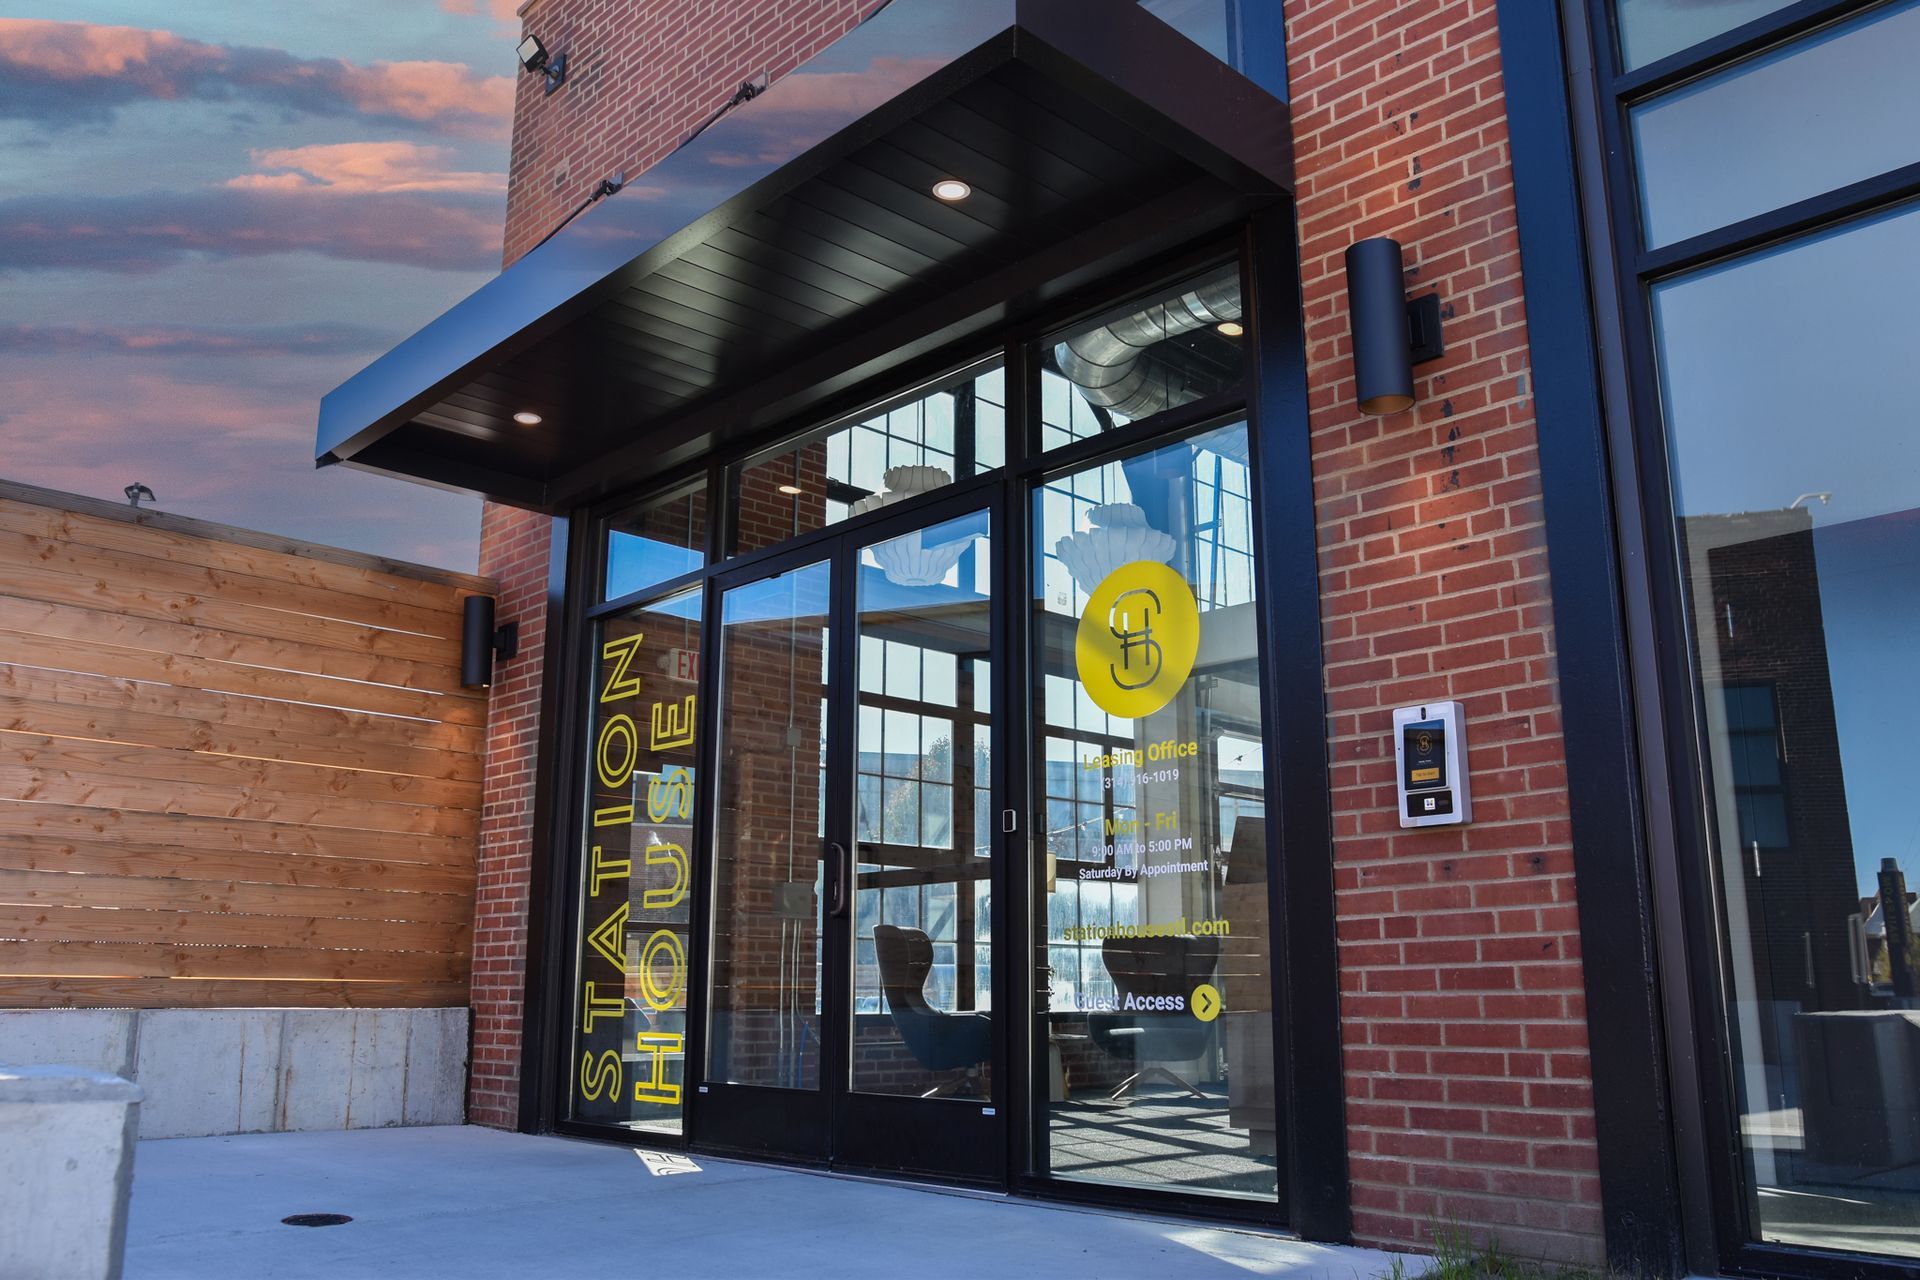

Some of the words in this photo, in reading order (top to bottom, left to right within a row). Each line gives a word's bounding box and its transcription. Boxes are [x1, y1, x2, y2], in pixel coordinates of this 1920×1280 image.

[1083, 748, 1144, 771] Leasing
[1147, 739, 1198, 762] Office
[1105, 818, 1140, 836] Mon
[1155, 811, 1177, 831] Fri
[1091, 844, 1113, 857] 9:00
[1116, 843, 1133, 855] AM
[1135, 842, 1146, 854] to
[1148, 840, 1172, 852] 5:00
[1174, 837, 1192, 851] PM
[580, 633, 643, 1104] STATION
[1079, 865, 1123, 880] Saturday
[1124, 864, 1138, 879] By
[1140, 859, 1209, 878] Appointment
[634, 695, 696, 1105] HOUSE
[1063, 917, 1230, 942] stationhousestl.com
[1074, 991, 1120, 1011] Guest
[1123, 991, 1185, 1011] Access
